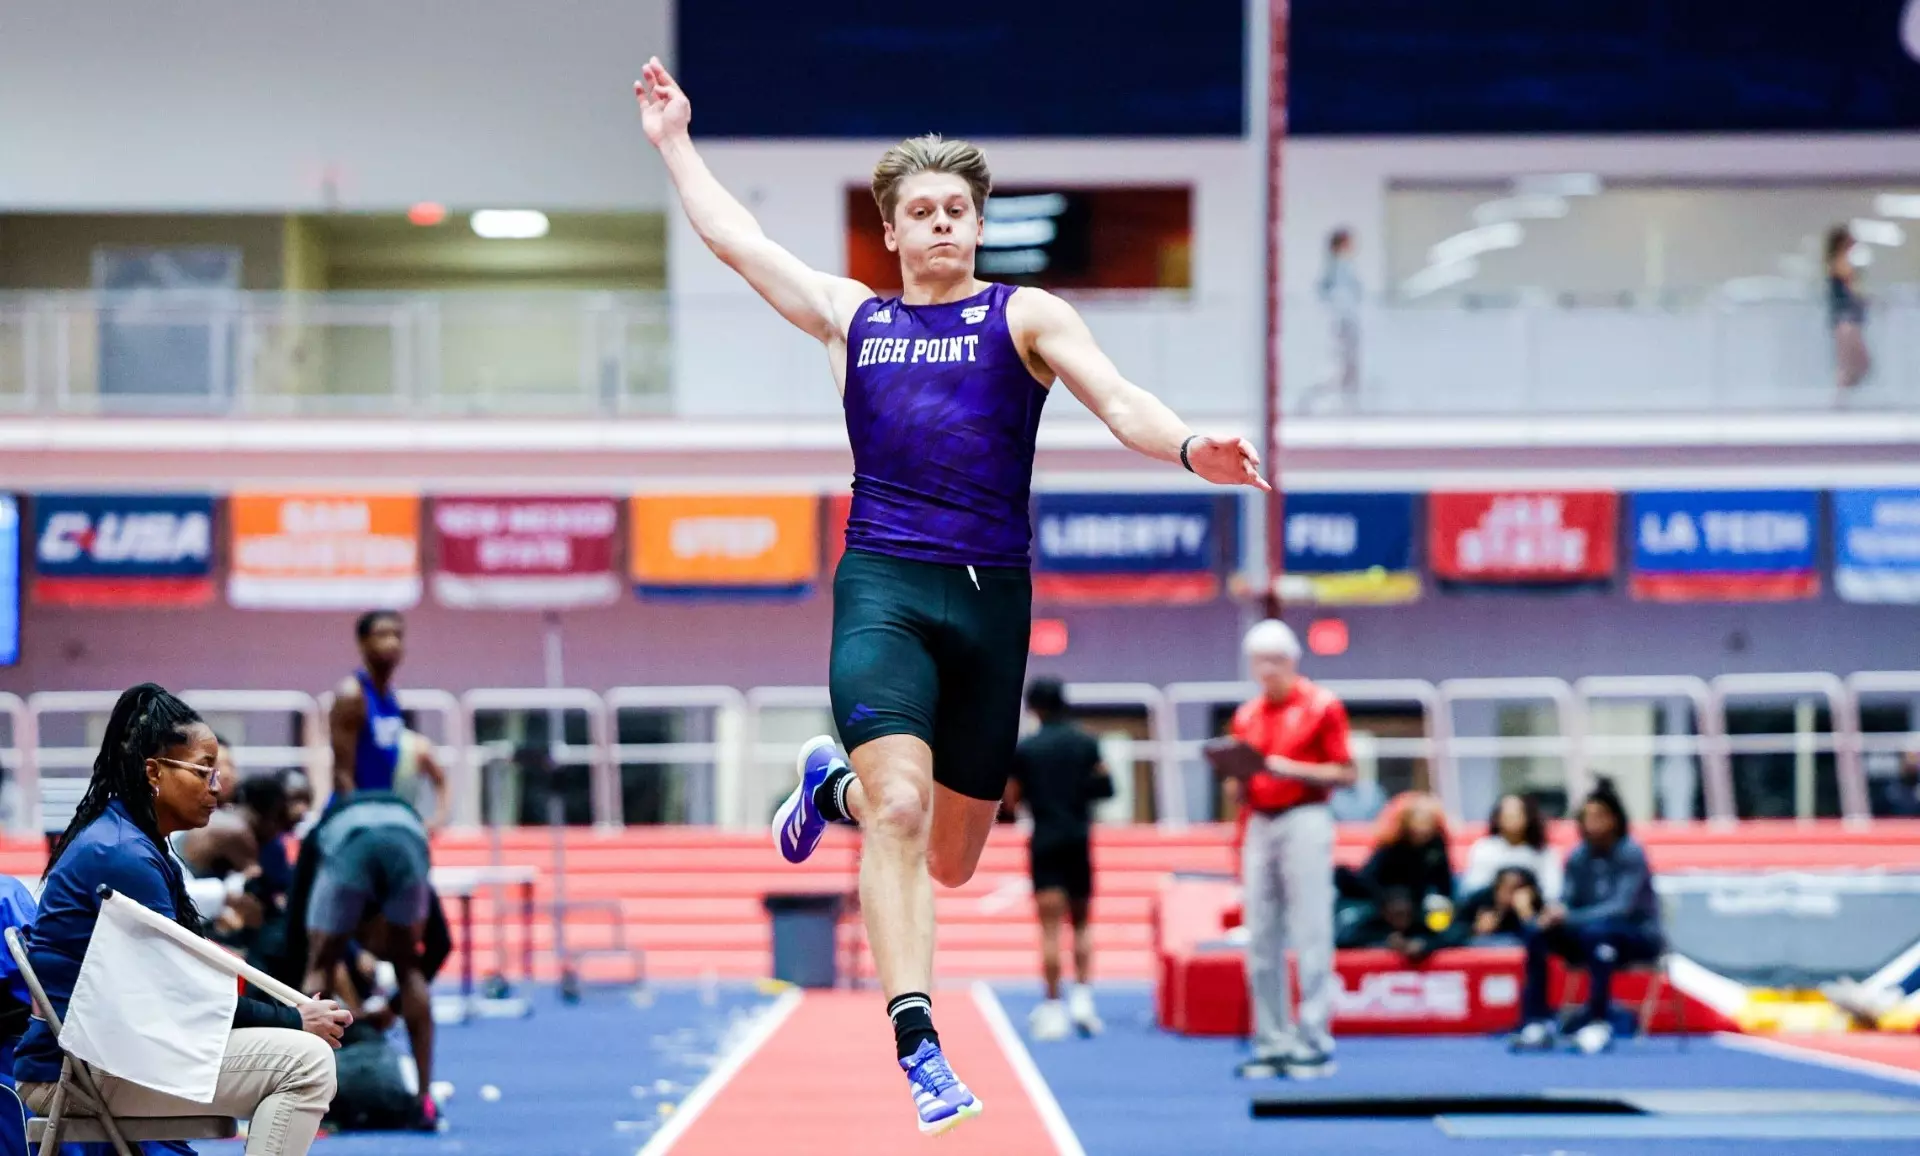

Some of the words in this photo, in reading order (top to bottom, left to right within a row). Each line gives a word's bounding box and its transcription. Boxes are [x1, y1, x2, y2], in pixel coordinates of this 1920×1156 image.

[857, 338, 910, 367] HIGH
[911, 335, 979, 364] POINT
[1040, 515, 1206, 555] LIBERTY
[1286, 515, 1359, 555] FIU
[1457, 530, 1587, 569] STATE
[1640, 513, 1696, 552] LA
[1703, 513, 1808, 552] TECH
[479, 538, 572, 568] STATE
